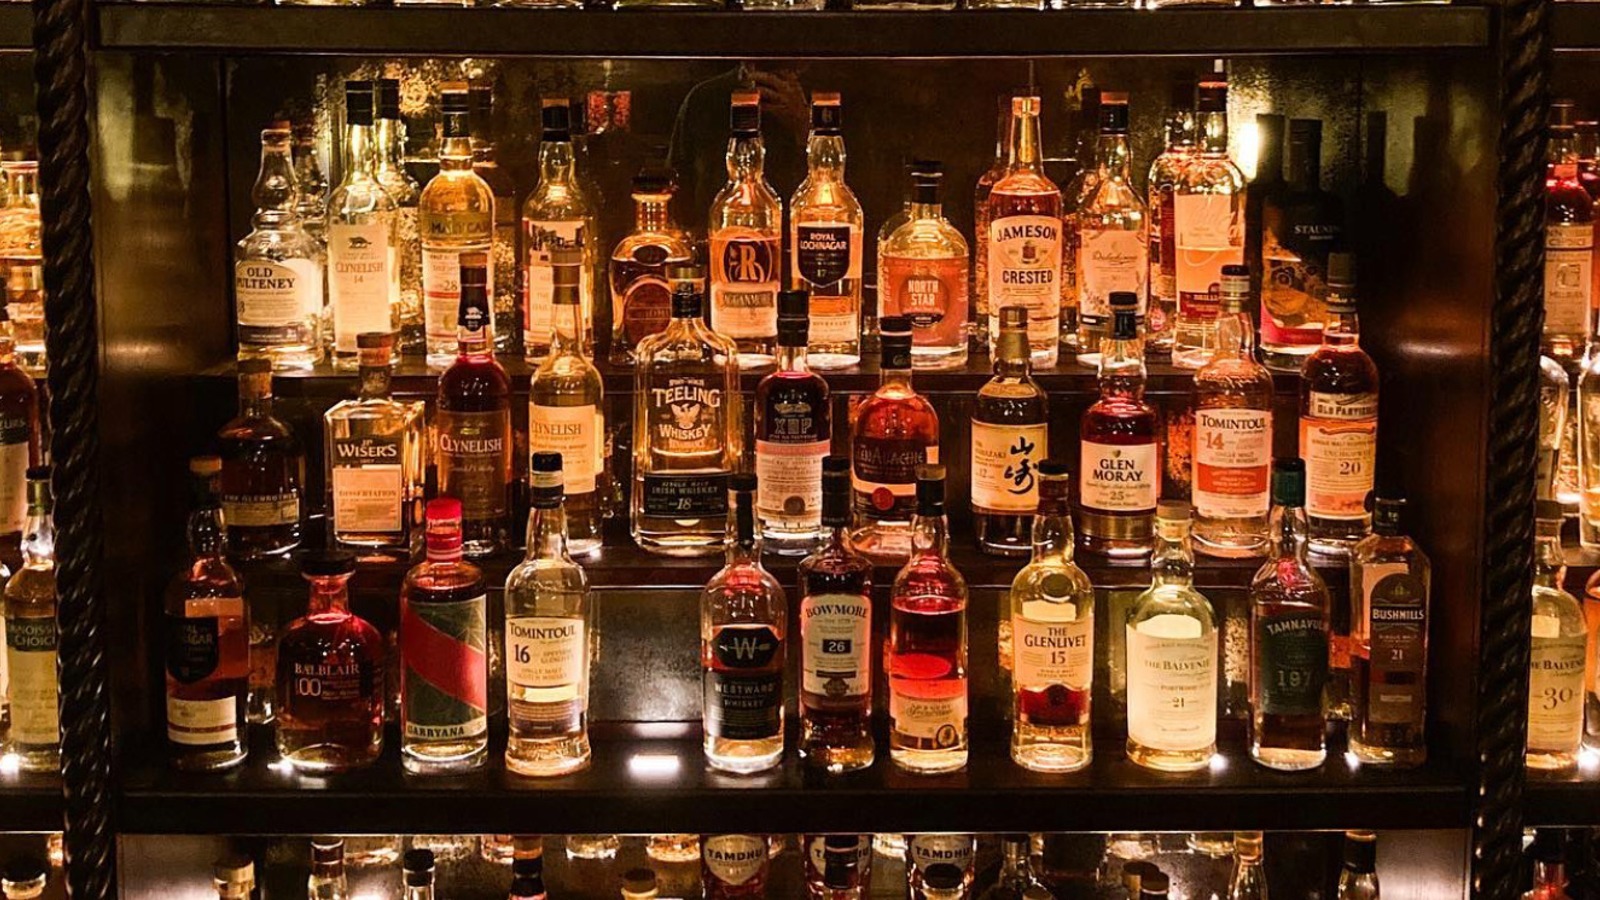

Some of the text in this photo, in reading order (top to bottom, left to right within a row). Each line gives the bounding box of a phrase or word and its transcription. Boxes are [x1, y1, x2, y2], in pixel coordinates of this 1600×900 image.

[810, 233, 836, 241] ROYAL
[996, 225, 1058, 242] JAMESON
[801, 241, 847, 250] LOCHNAGAR
[247, 267, 273, 278] OLD
[335, 261, 384, 273] CLYNELISH
[353, 275, 364, 284] 14
[1002, 270, 1053, 284] CRESTED
[443, 279, 458, 291] 28
[908, 280, 939, 293] NORTH
[910, 293, 935, 306] STAR
[651, 386, 720, 407] TEELING
[1318, 404, 1334, 415] OLD
[1201, 414, 1266, 430] TOMINTOUL
[659, 423, 711, 440] WHISKEY
[440, 433, 502, 452] CLYNELISH
[1205, 432, 1225, 449] 14
[1100, 458, 1135, 470] GLEN
[1340, 461, 1361, 475] 20
[1093, 470, 1143, 482] MORAY
[1109, 491, 1125, 501] 25
[677, 498, 692, 511] 18
[805, 605, 867, 618] BOWMORE
[1372, 608, 1424, 620] BUSHMILLS
[510, 621, 576, 640] TOMINTOUL
[1047, 627, 1067, 636] THE
[828, 641, 845, 652] 26
[1025, 634, 1086, 648] GLENLIVET
[514, 644, 531, 664] 16
[733, 637, 757, 660] W
[1391, 649, 1404, 661] 21
[1050, 651, 1066, 664] 15
[294, 662, 360, 676] BALBLAIR
[1543, 659, 1584, 670] BALVEN
[714, 682, 774, 694] WESTWARD
[1543, 687, 1573, 710] 30
[408, 725, 465, 738] GARRYANA
[708, 848, 762, 862] TAMDHU
[916, 846, 970, 859] TAMDHU
